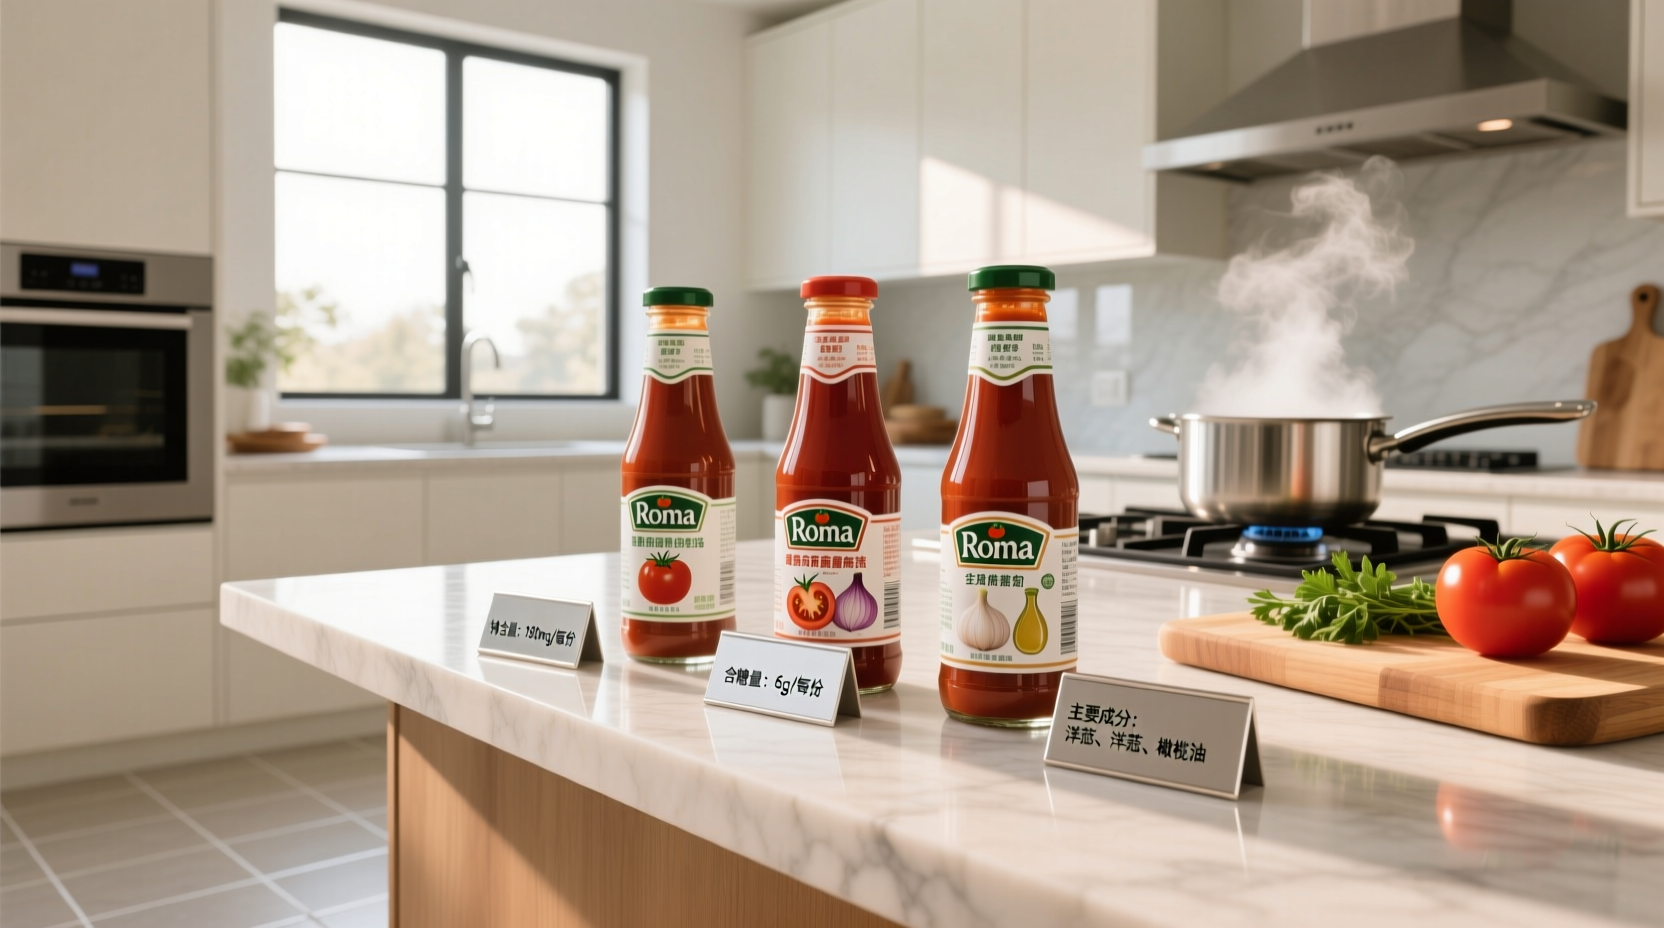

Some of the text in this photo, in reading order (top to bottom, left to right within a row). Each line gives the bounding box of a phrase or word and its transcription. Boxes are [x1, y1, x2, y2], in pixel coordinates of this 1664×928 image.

[636, 501, 696, 525] Roma
[791, 516, 854, 544] Roma
[961, 531, 1034, 560] Roma
